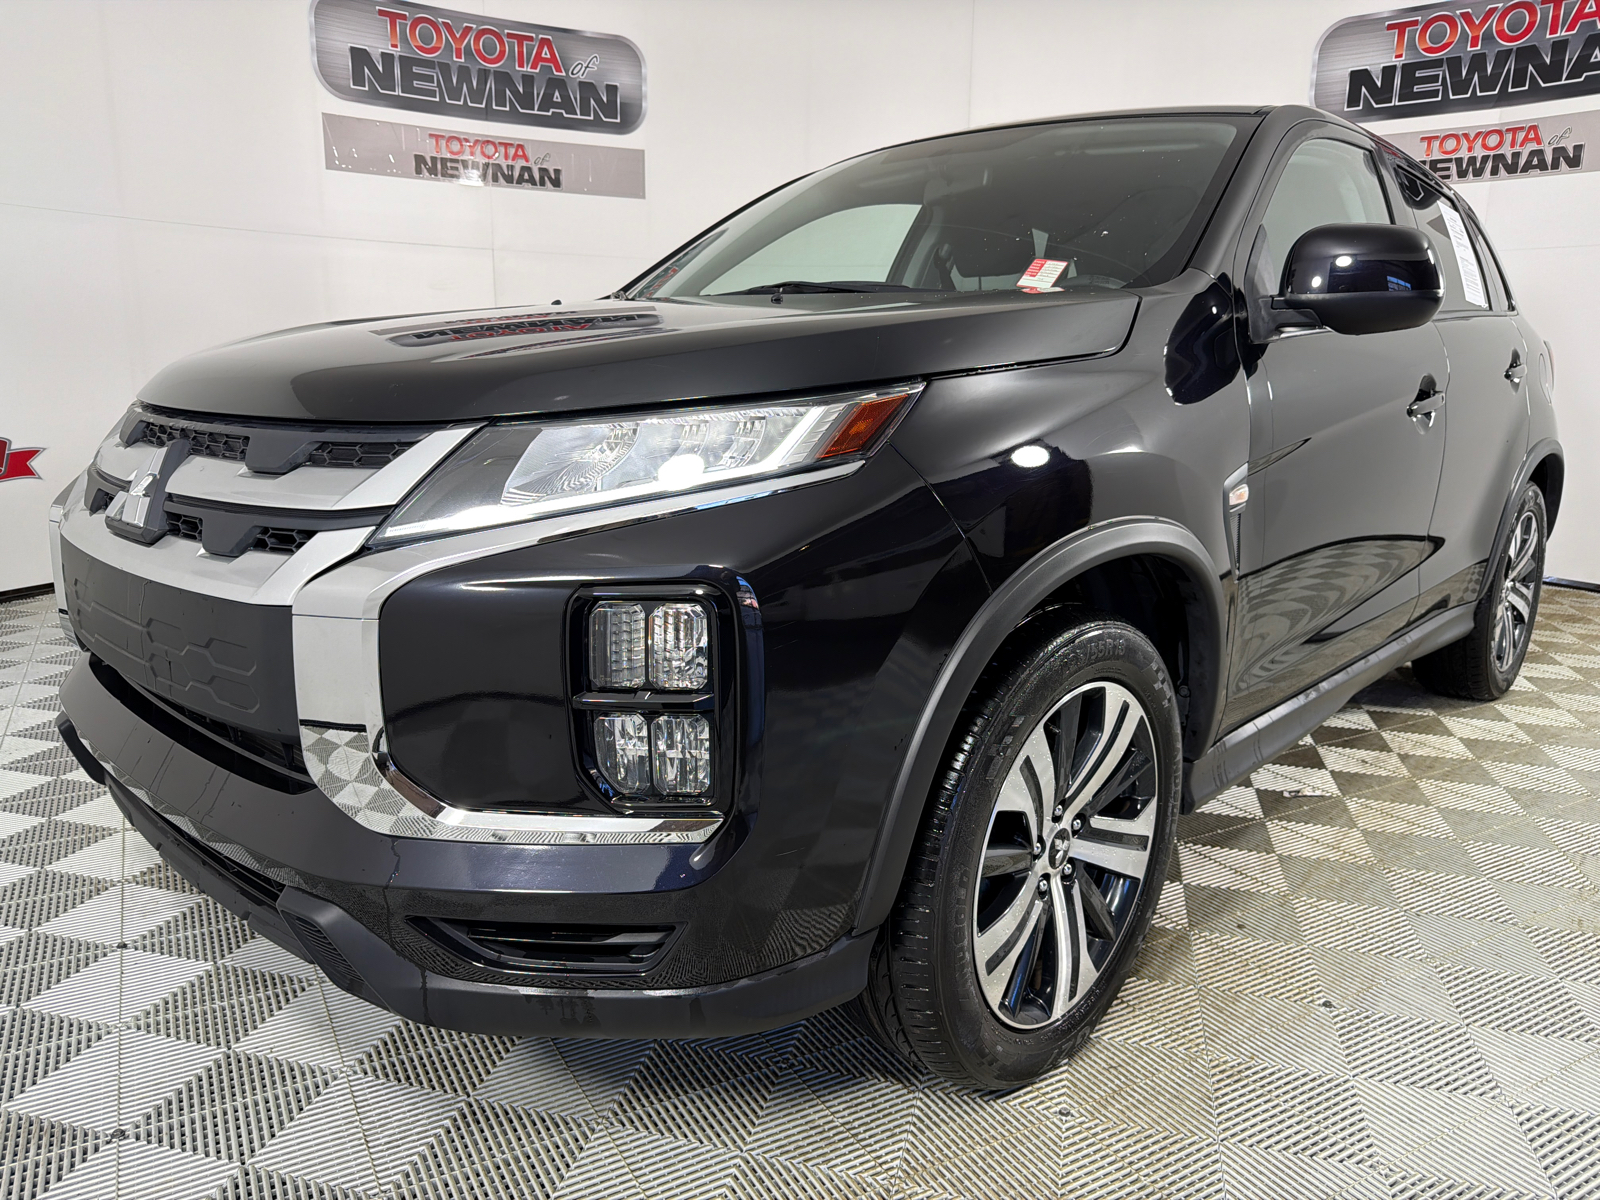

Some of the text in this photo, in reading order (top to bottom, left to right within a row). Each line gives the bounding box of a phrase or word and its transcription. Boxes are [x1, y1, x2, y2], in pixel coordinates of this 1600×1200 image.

[376, 7, 599, 79] TOYOTA of
[1386, 0, 1600, 60] TOYOTA
[348, 44, 620, 122] NEWNAN
[428, 132, 551, 166] TOYOTA of
[1420, 123, 1572, 157] TOYOTA of
[413, 153, 562, 188] NEWNAN
[1419, 142, 1585, 182] EWNAN
